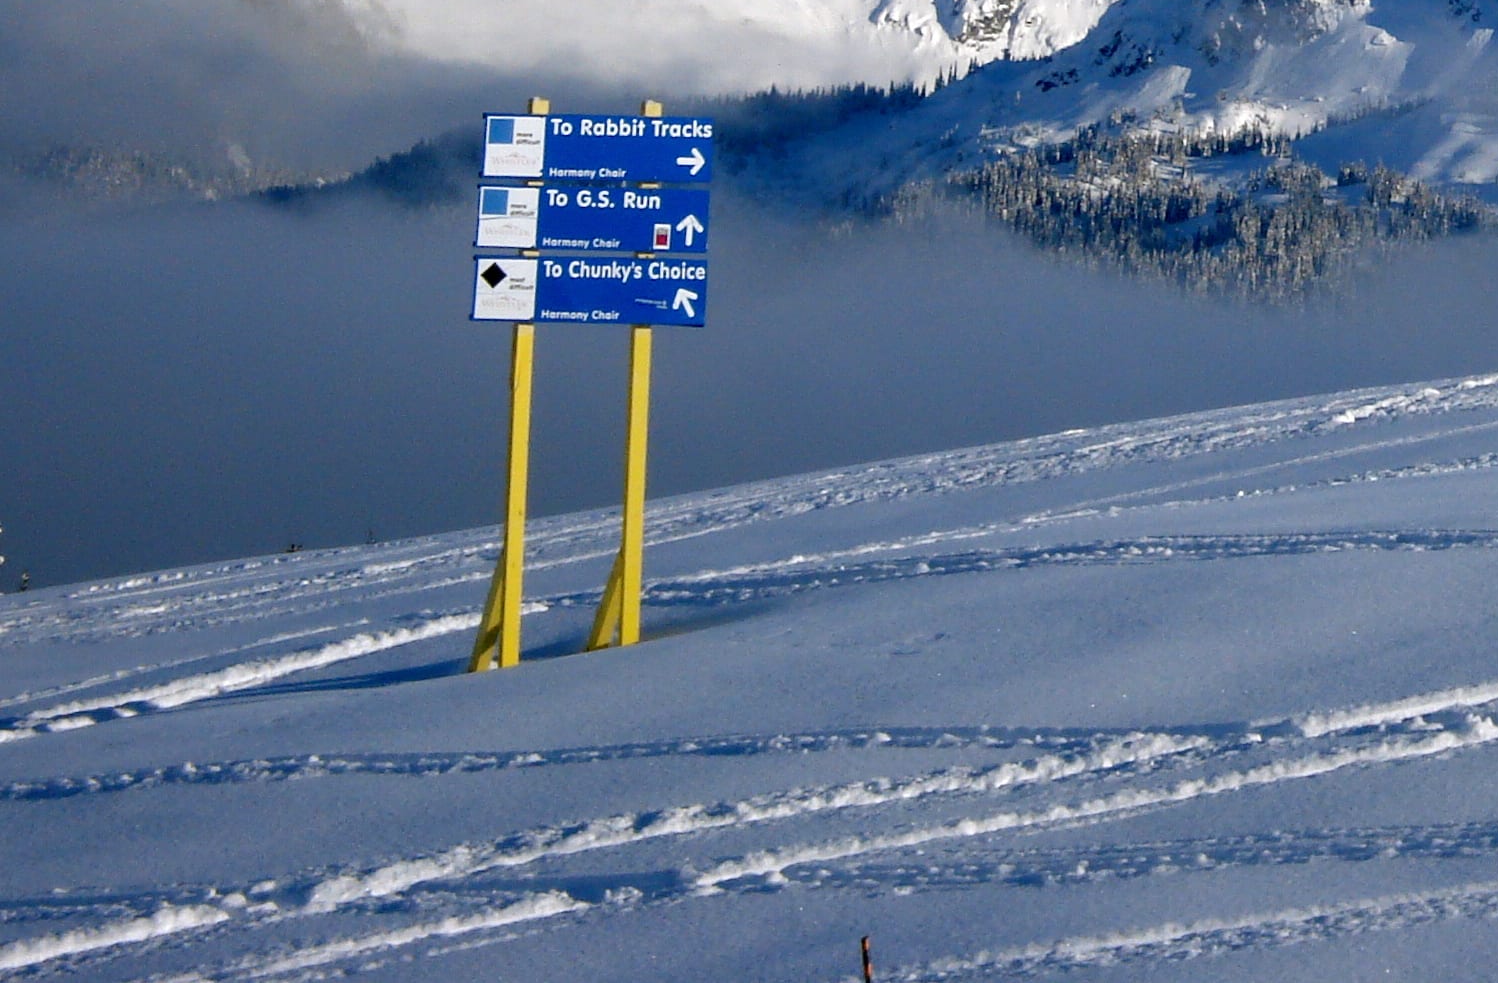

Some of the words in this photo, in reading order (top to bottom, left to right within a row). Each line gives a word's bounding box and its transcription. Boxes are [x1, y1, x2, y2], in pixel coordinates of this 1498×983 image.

[551, 119, 573, 136] To
[580, 119, 646, 137] Rabbit
[651, 120, 713, 138] Tracks
[548, 168, 597, 180] Harmony
[598, 168, 627, 179] Chair
[546, 189, 568, 207] To
[576, 190, 615, 209] G.S.
[623, 192, 661, 209] Run
[541, 237, 590, 249] Harmony
[592, 238, 621, 249] Chair
[543, 260, 563, 278] To
[568, 261, 643, 283] Chunky's
[647, 262, 706, 280] Choice
[540, 309, 589, 321] Harmony
[591, 310, 620, 321] Chair
